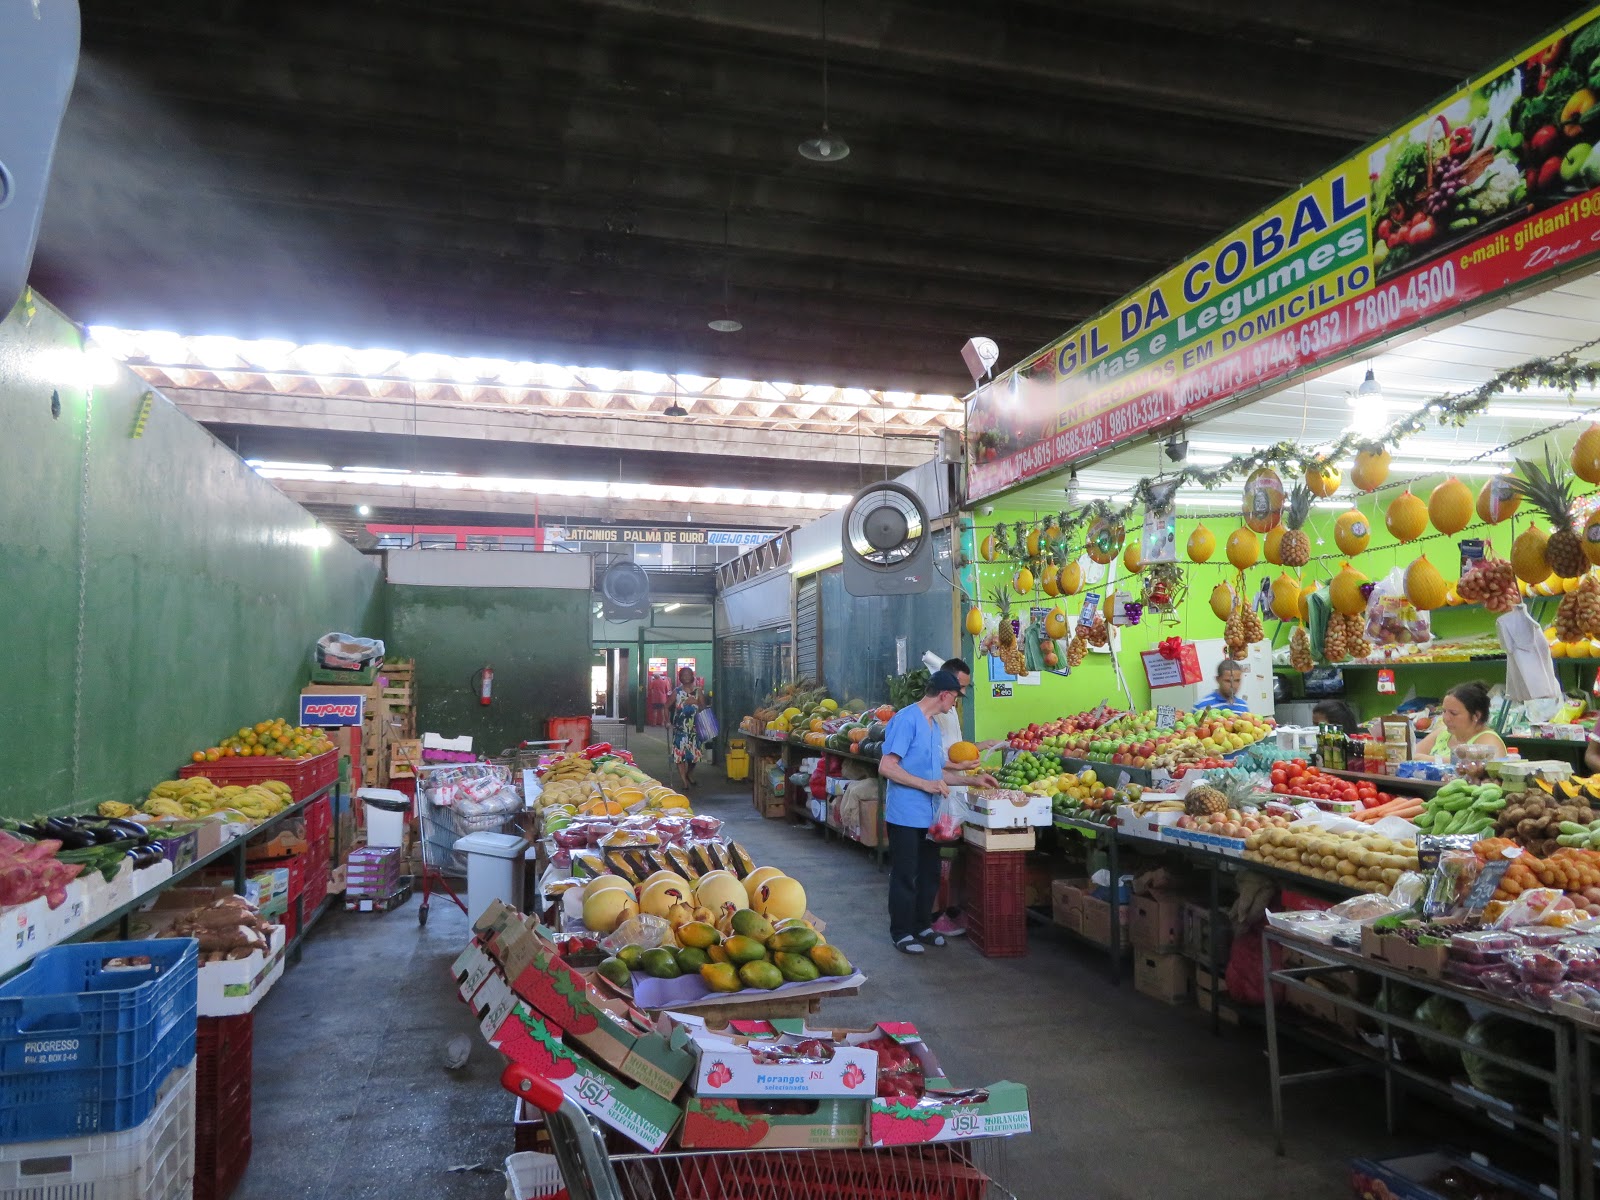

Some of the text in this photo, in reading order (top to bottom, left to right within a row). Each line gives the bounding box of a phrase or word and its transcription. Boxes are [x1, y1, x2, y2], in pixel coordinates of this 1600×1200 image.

[1460, 234, 1510, 270] e-mail:
[1058, 176, 1367, 376] GIL DA COBAL
[1149, 333, 1167, 354] e
[1177, 226, 1364, 341] Legumes
[1182, 339, 1214, 370] EM
[1222, 265, 1370, 352] DOMICÍLIO
[1056, 418, 1102, 458] 99585-3236
[1109, 393, 1165, 437] 98618-3321
[1354, 260, 1456, 334] 7800-4500
[623, 531, 661, 542] PALMA
[664, 532, 676, 543] DE
[305, 704, 358, 717] Rivoira
[24, 1039, 79, 1052] PROGRESSO
[757, 1074, 805, 1084] Morangos
[808, 1070, 825, 1080] JSL
[573, 1078, 604, 1108] JSL
[606, 1108, 658, 1145] SELECIONADOS
[611, 1100, 662, 1138] MORANGOS
[950, 1116, 980, 1131] JSL
[983, 1123, 1029, 1132] SELECIONADOS
[984, 1114, 1028, 1124] MORANGOS
